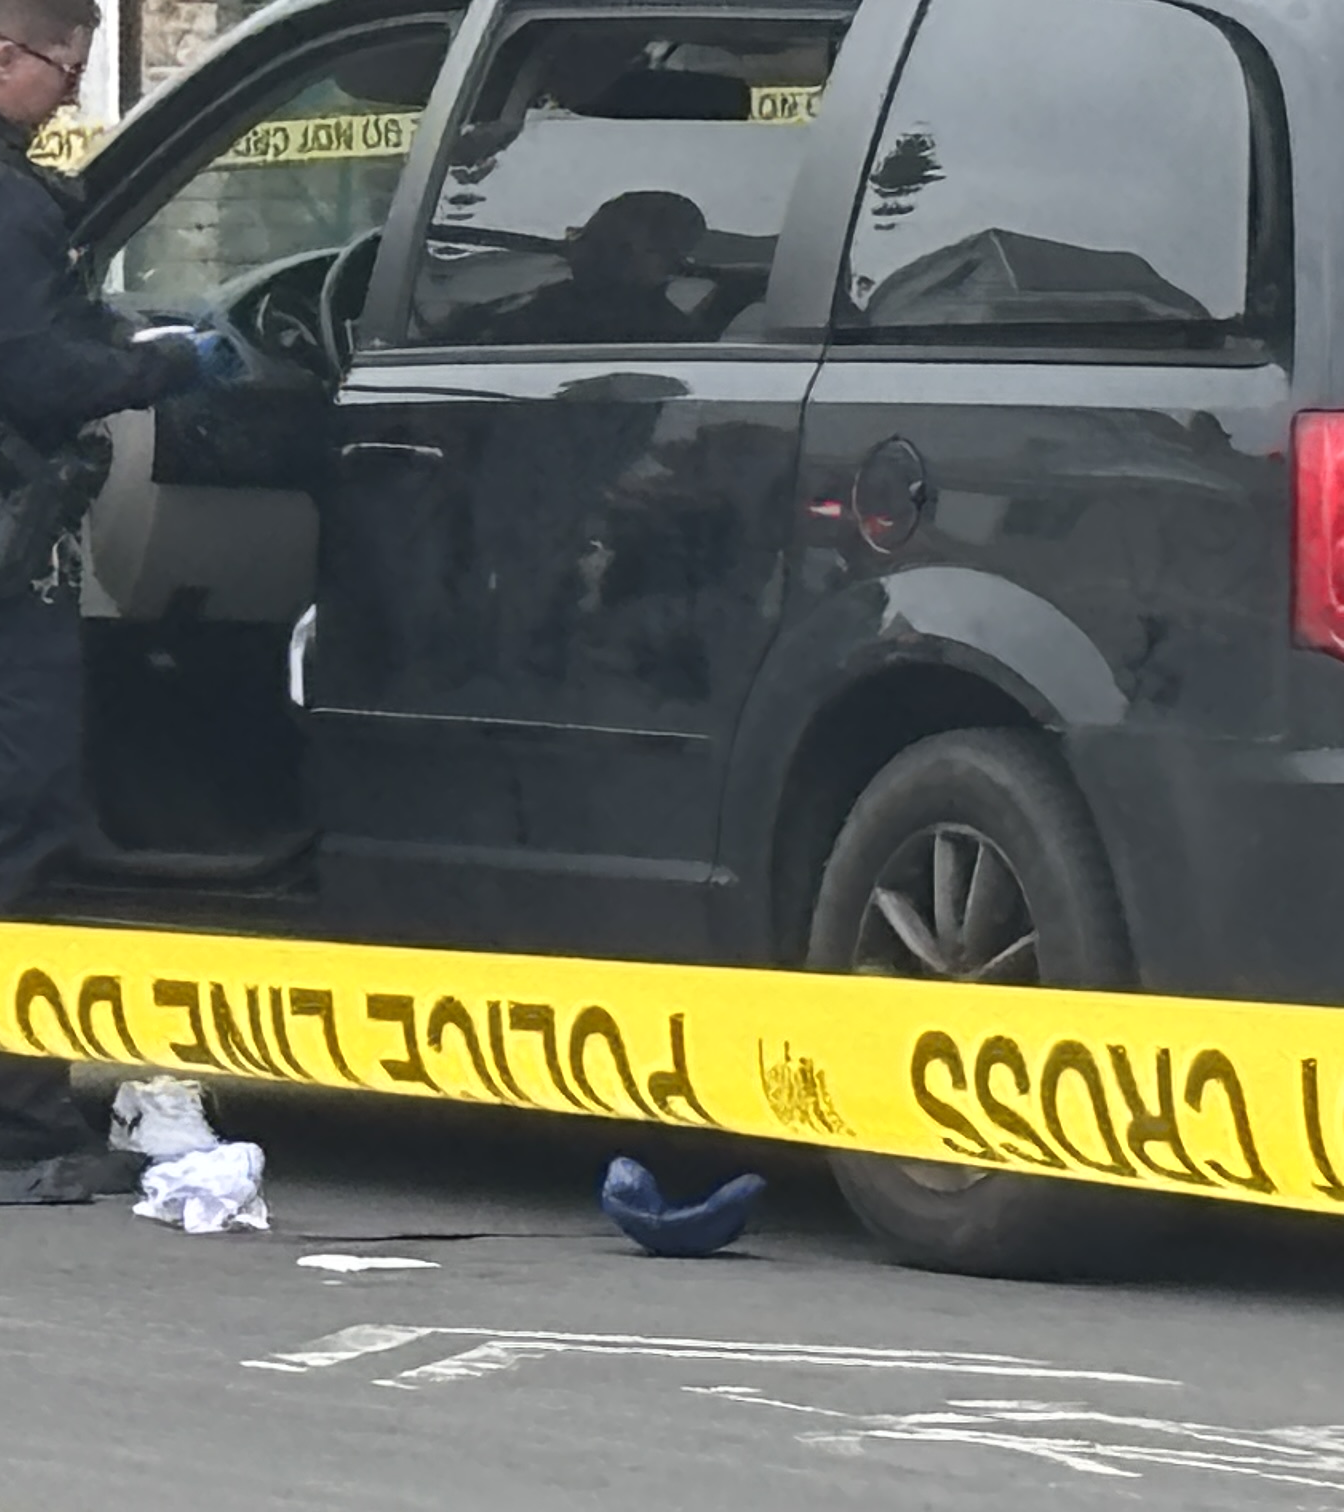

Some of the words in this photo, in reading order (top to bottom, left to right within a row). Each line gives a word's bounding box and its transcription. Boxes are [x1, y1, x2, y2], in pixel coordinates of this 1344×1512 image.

[14, 966, 145, 1064] DO
[151, 976, 362, 1085] LINE
[365, 991, 724, 1127] POLICE
[911, 1029, 1279, 1195] CROSS
